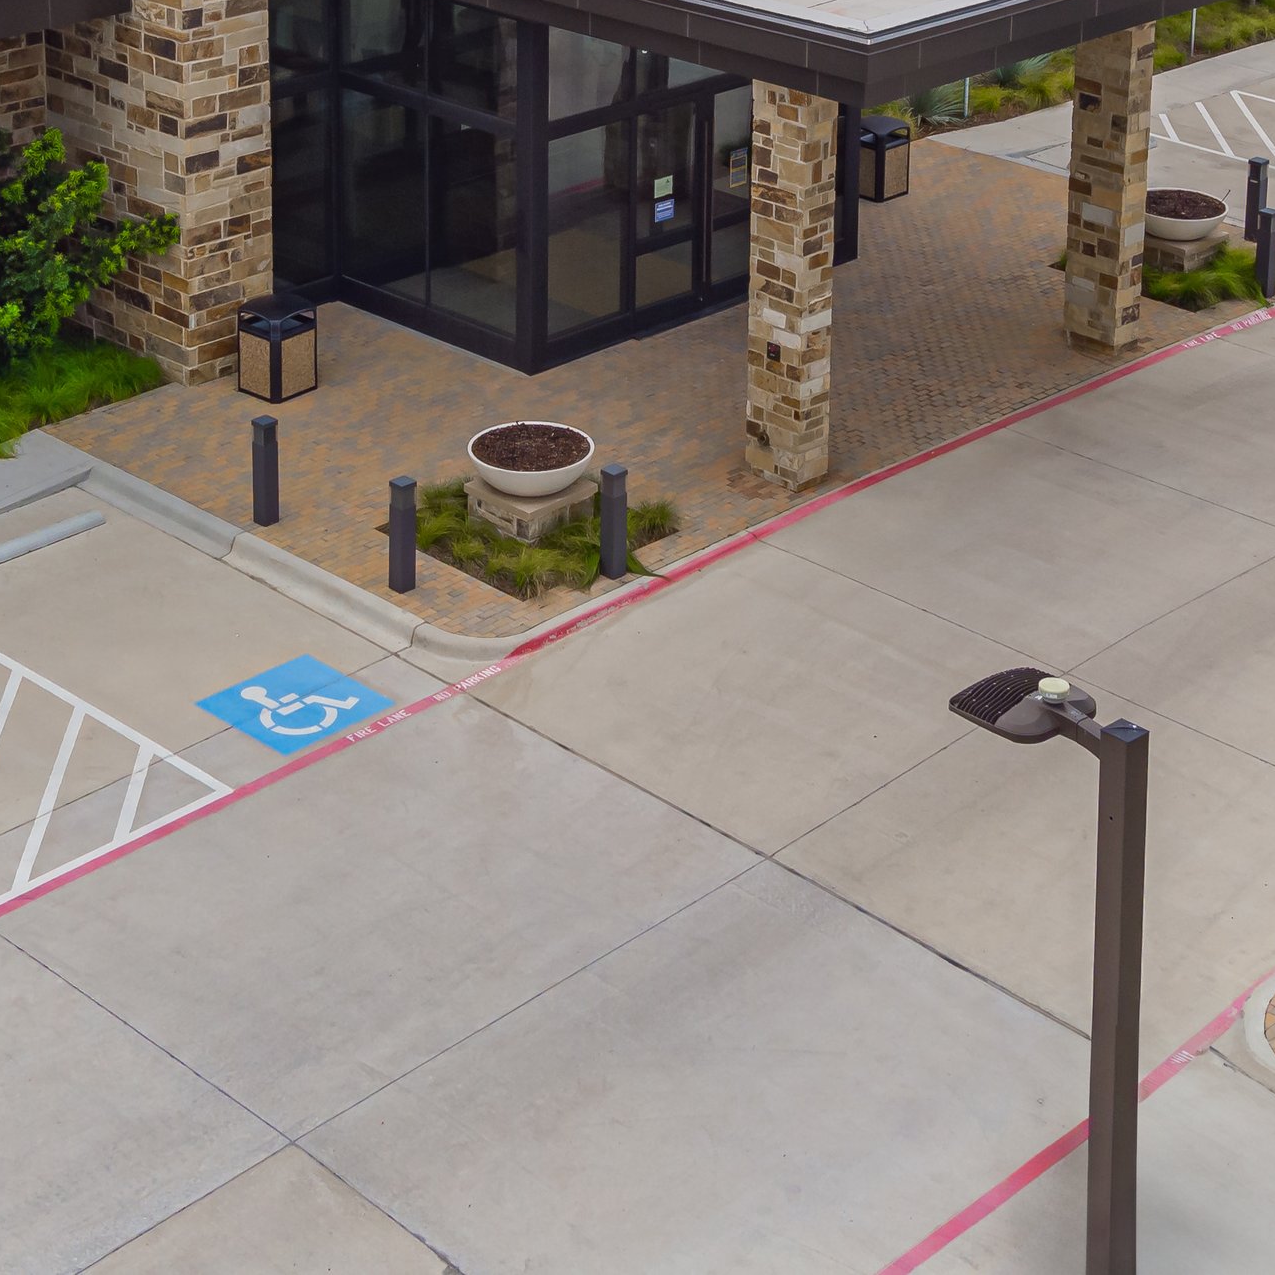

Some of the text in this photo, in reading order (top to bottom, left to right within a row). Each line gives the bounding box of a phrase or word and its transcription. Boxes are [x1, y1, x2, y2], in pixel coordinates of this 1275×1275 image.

[346, 726, 377, 742] FIRE
[377, 709, 412, 728] LANE
[453, 665, 502, 692] PARKING
